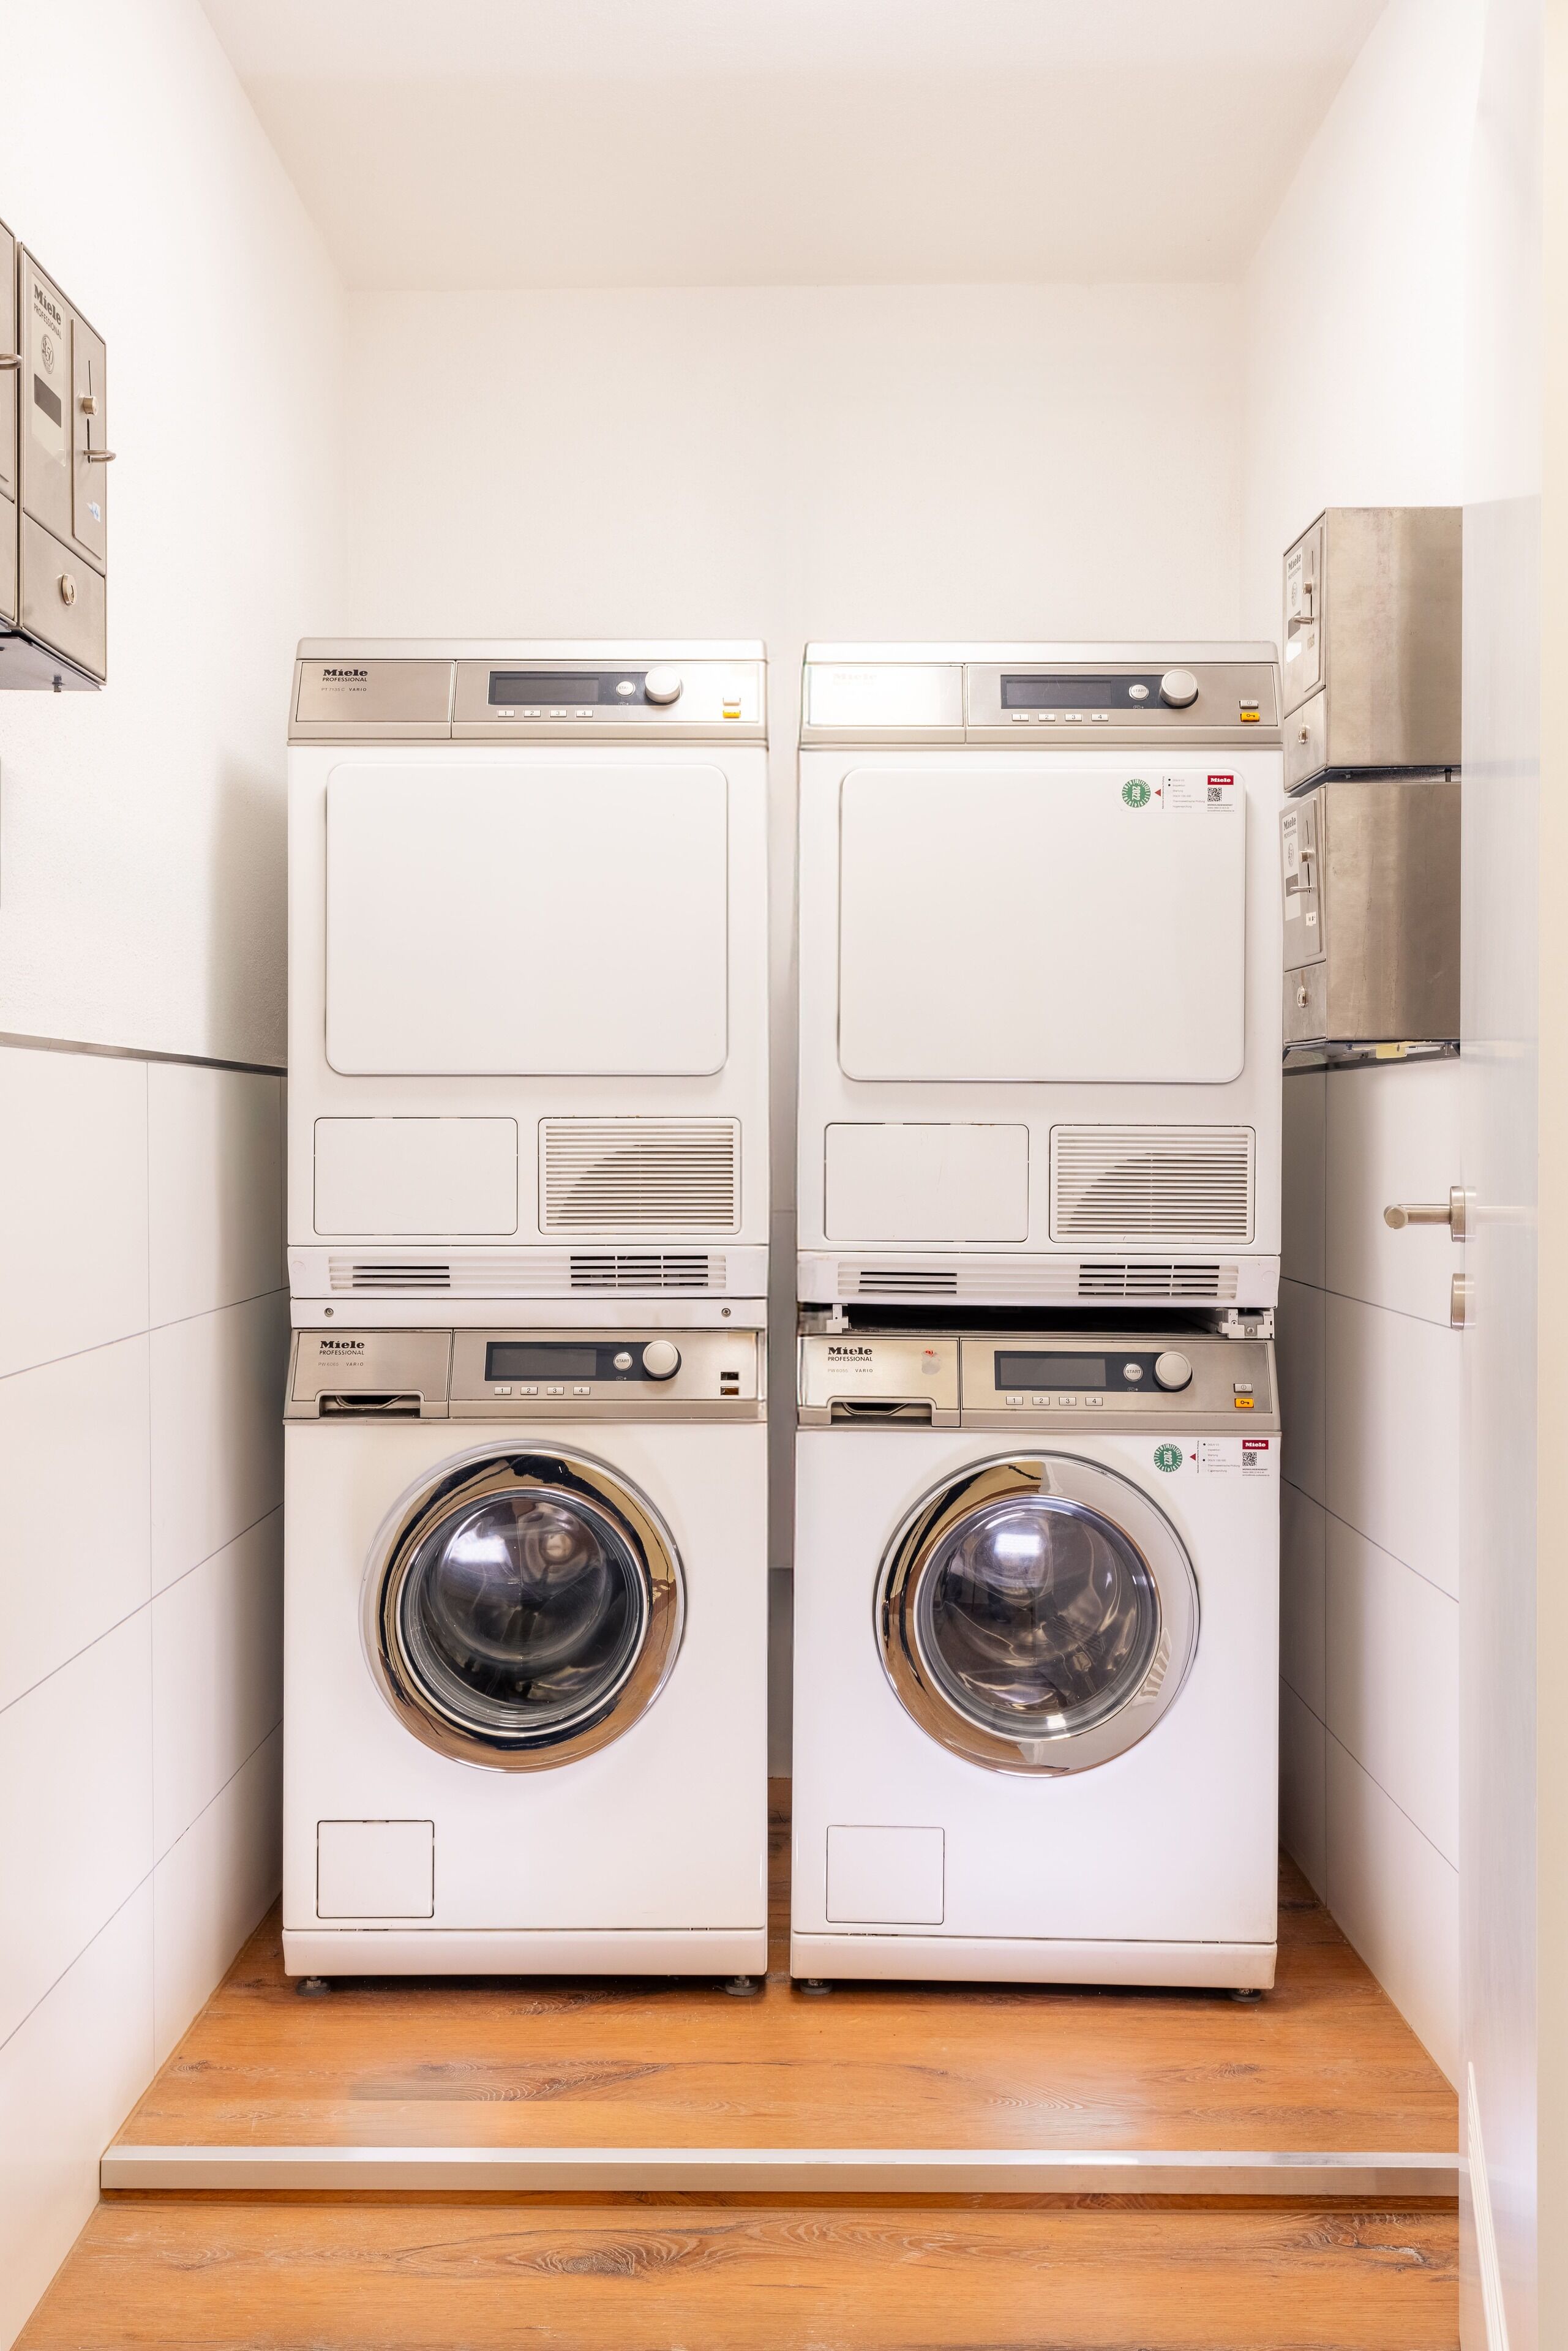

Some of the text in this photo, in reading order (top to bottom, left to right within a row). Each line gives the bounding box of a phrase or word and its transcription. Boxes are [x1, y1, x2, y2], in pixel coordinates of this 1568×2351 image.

[34, 283, 61, 325] Miele
[34, 302, 62, 340] PROFESSIONAL
[1288, 553, 1301, 572] Miele
[1132, 786, 1141, 800] 2022
[1283, 817, 1296, 830] Miele
[1164, 1451, 1172, 1465] 2022
